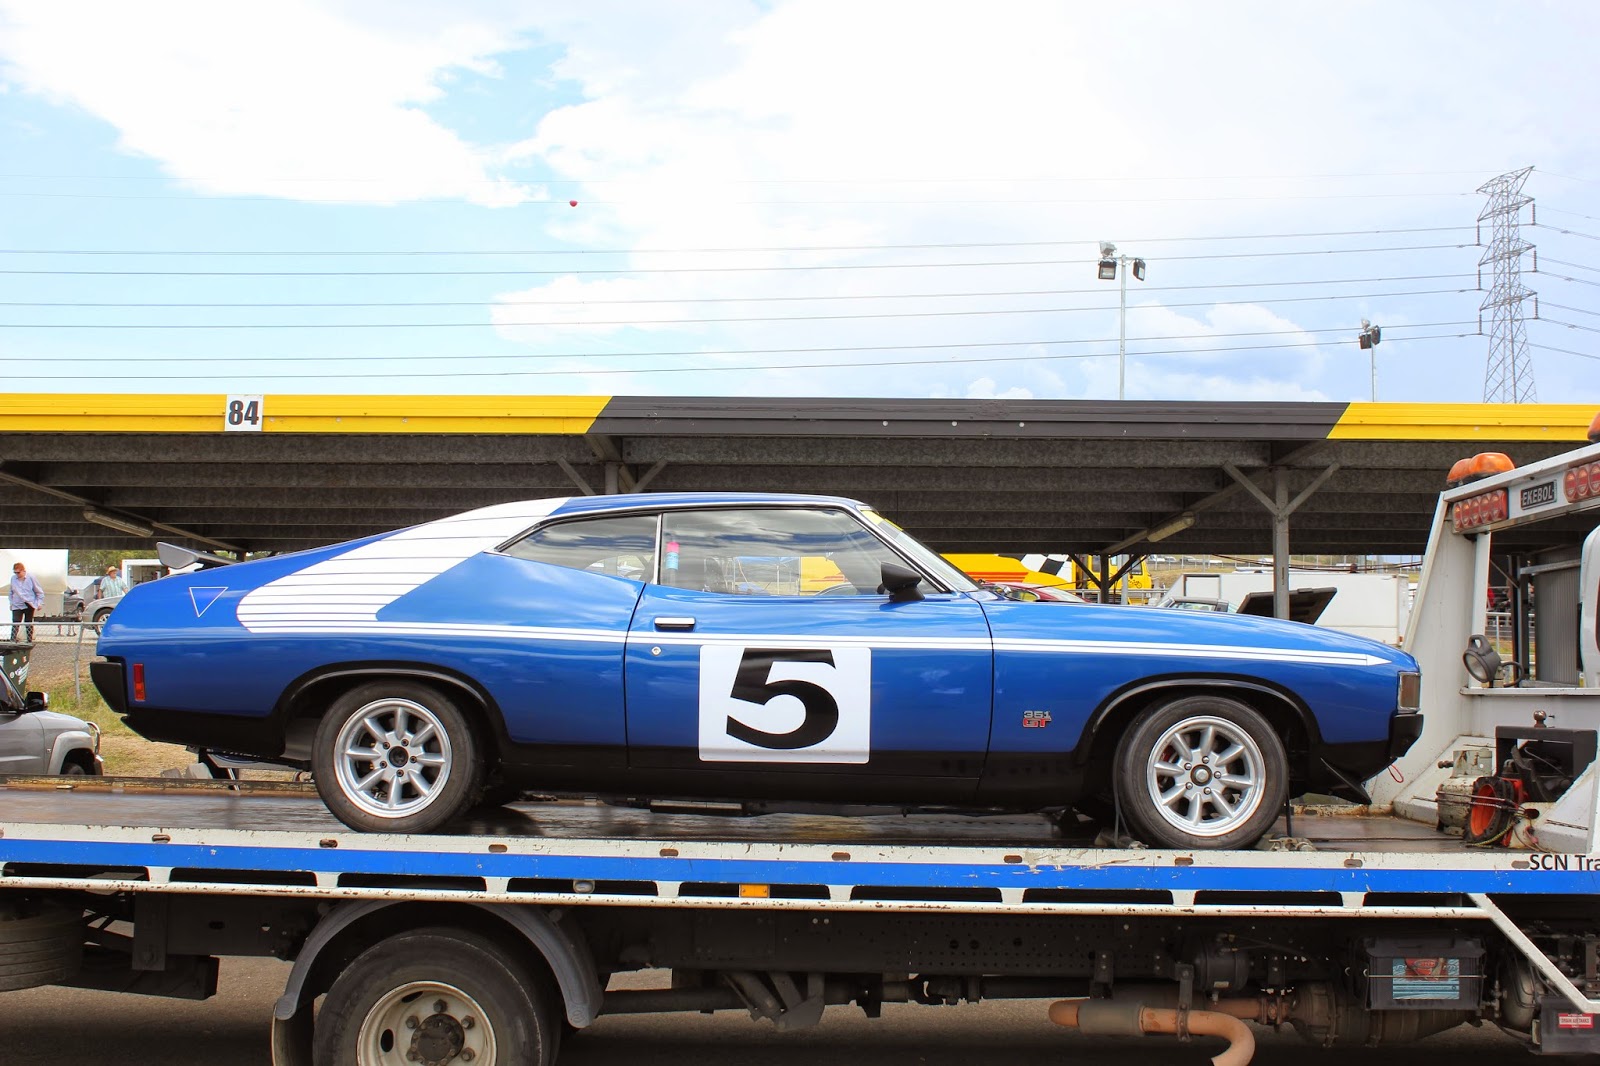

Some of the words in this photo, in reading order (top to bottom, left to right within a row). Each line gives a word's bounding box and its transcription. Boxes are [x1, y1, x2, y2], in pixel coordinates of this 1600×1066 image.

[228, 400, 259, 425] 84
[1522, 485, 1553, 506] EKEBOL
[726, 647, 839, 749] 5
[1023, 710, 1051, 719] 351
[1023, 717, 1051, 728] GT
[1529, 854, 1568, 870] SCN
